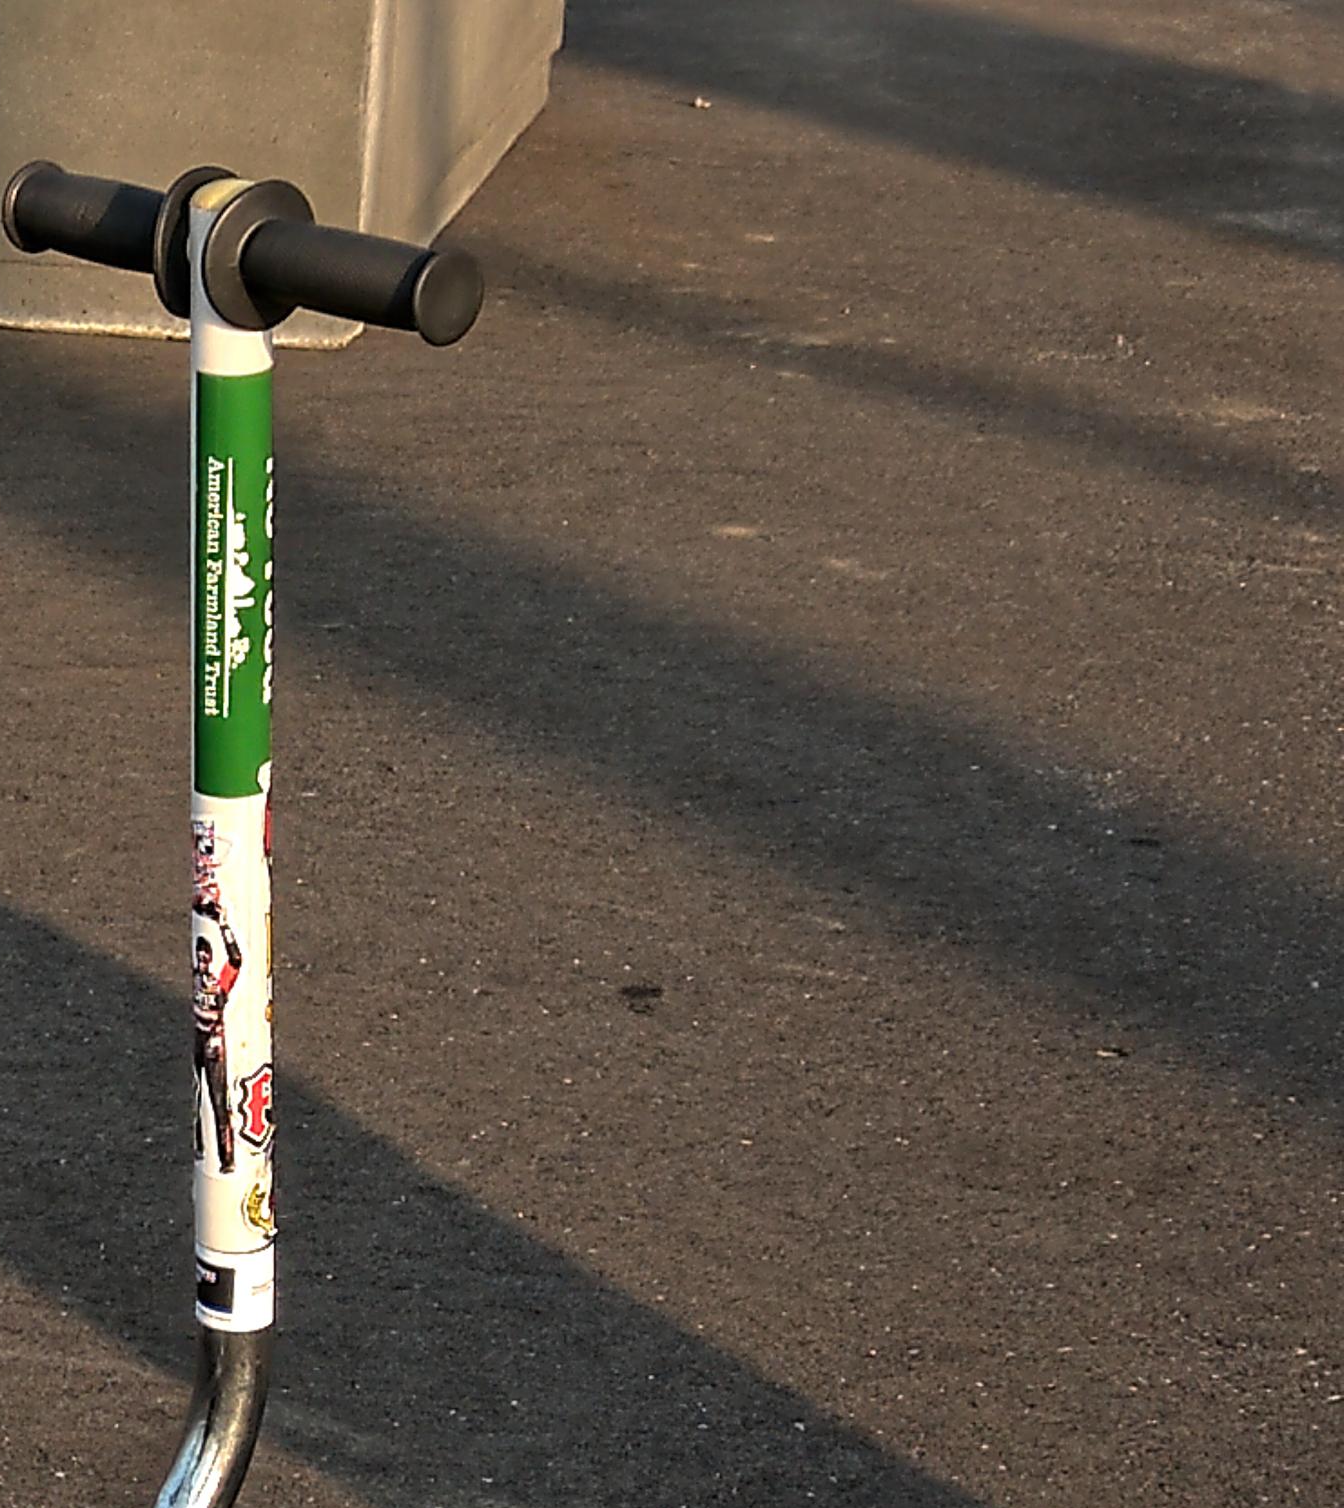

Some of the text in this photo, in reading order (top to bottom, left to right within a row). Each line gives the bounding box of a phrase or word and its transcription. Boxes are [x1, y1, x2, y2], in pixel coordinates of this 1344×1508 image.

[203, 456, 226, 717] American Farmland Trust
